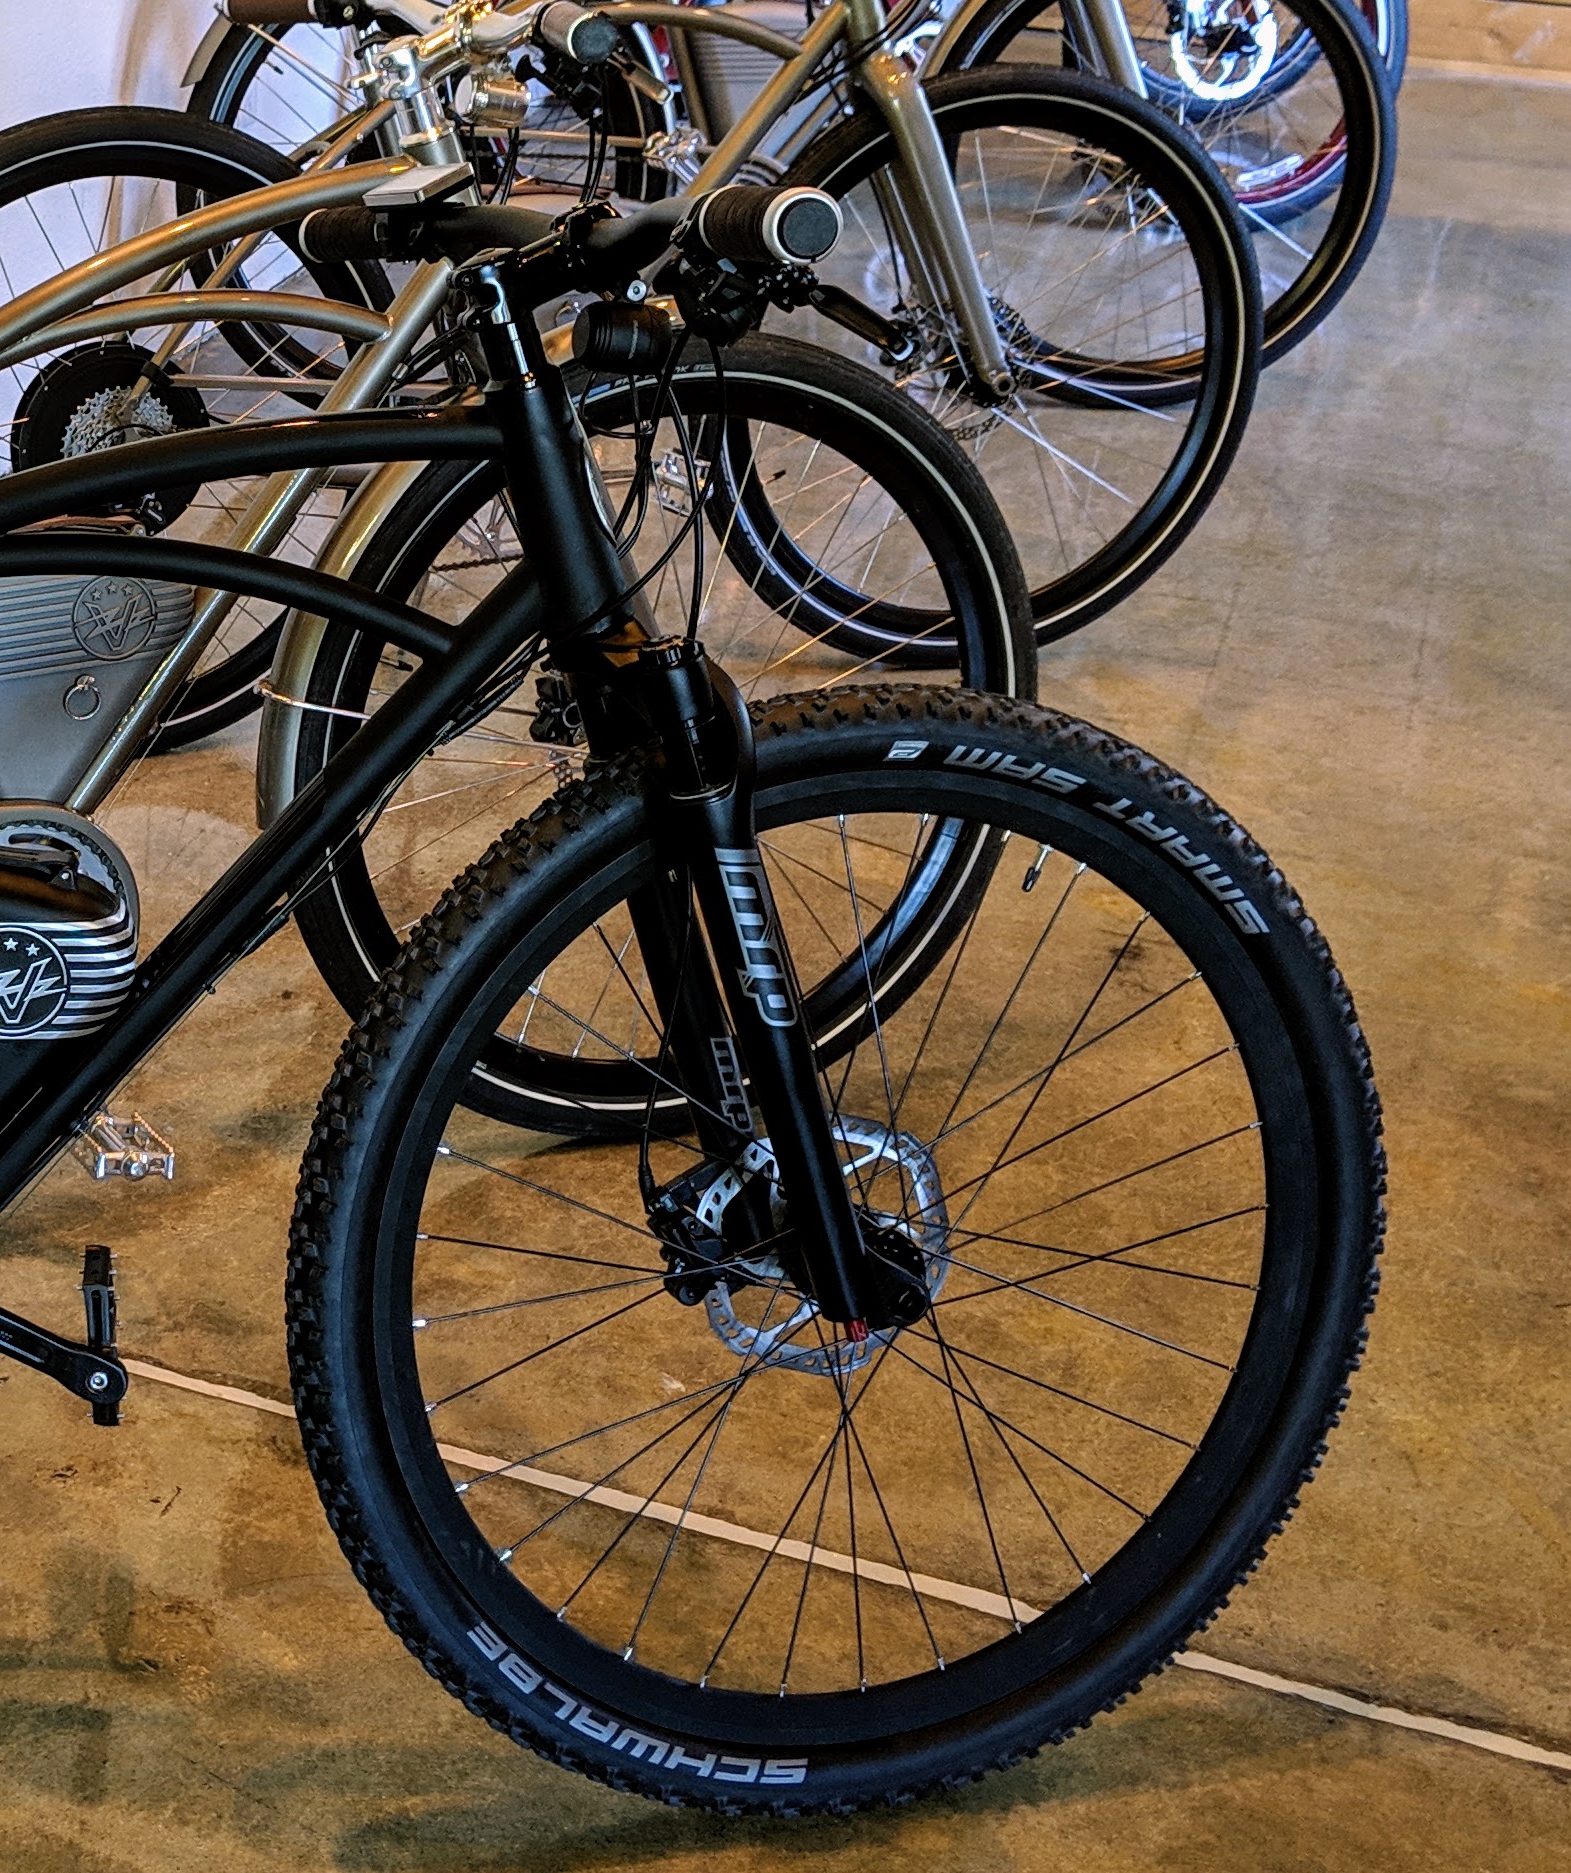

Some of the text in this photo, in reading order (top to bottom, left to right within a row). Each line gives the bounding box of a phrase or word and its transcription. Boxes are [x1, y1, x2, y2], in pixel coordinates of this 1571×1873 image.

[943, 745, 1088, 794] SAM
[1093, 797, 1270, 934] SMART
[466, 1620, 809, 1785] SCHWALBE
